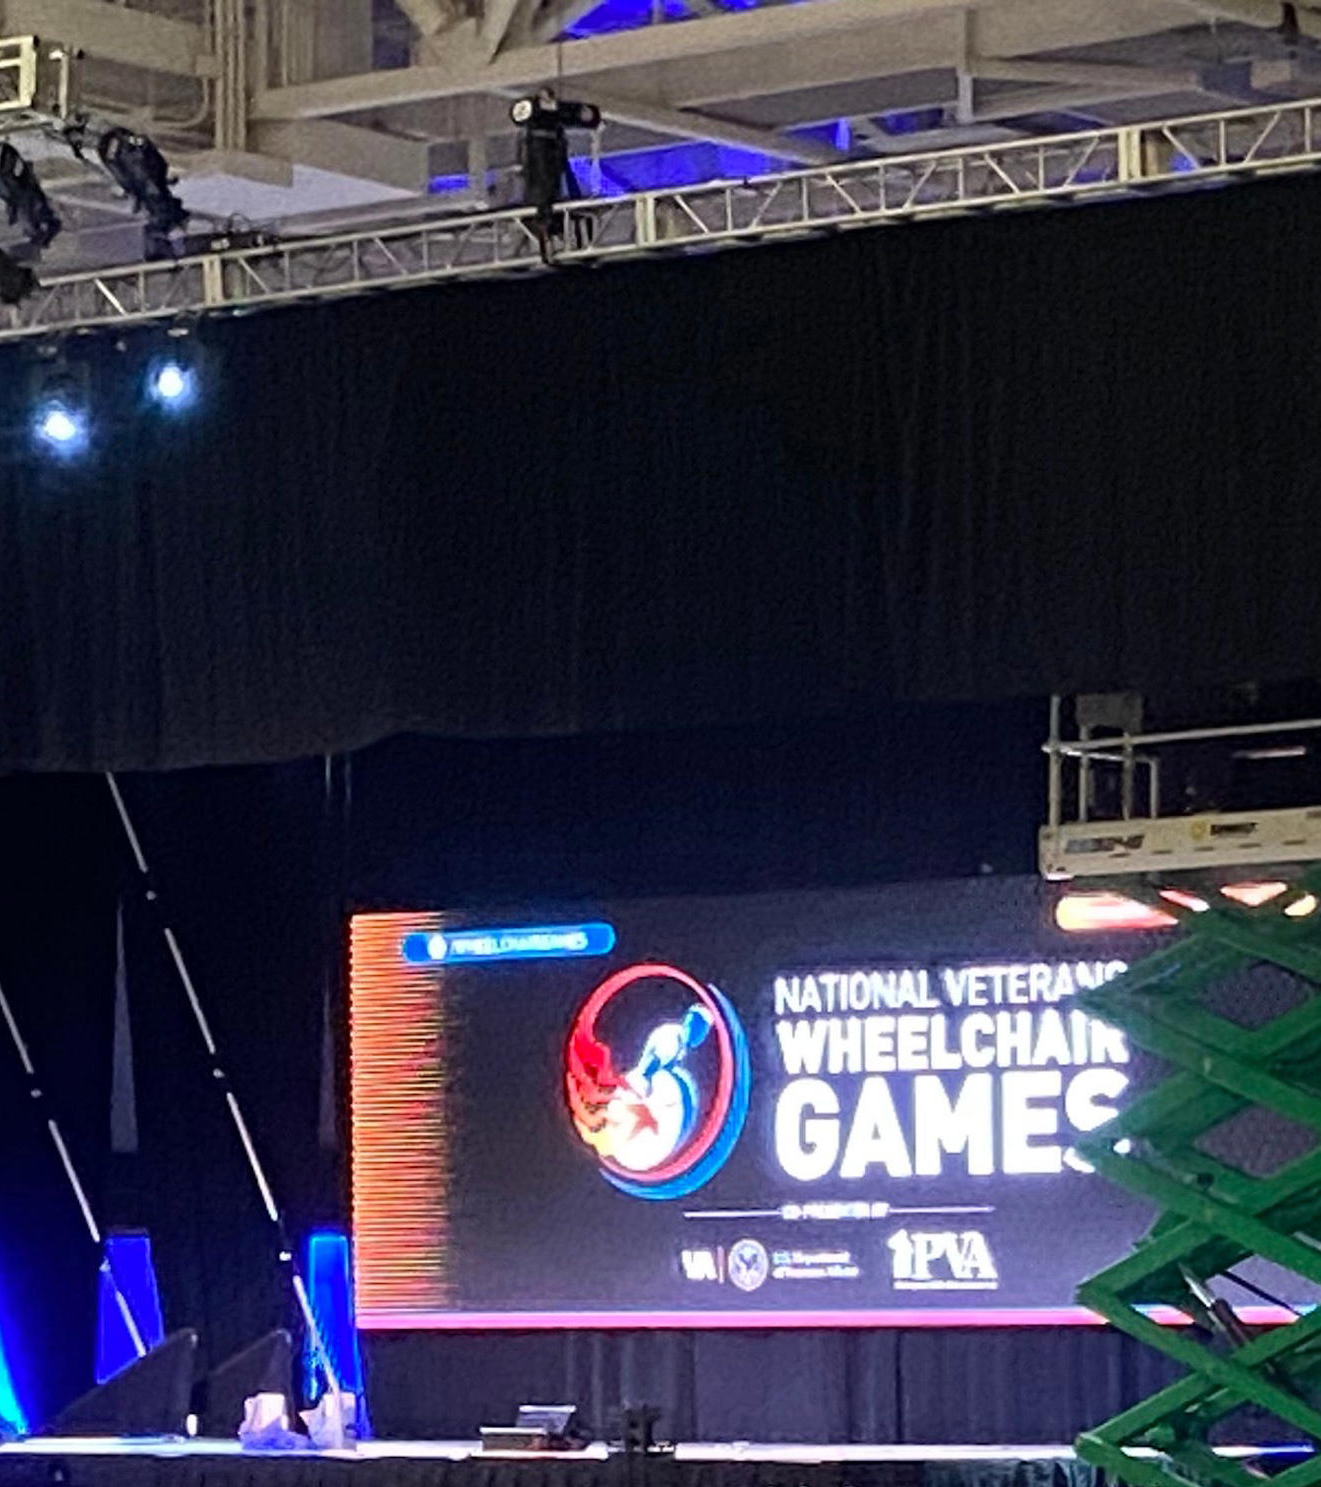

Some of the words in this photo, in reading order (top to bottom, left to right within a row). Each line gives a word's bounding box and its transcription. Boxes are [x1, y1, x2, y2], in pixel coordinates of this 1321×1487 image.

[774, 968, 941, 1015] NATIONAL
[776, 1008, 1130, 1075] WHEELCHAIR
[774, 1068, 1130, 1182] GAMES
[910, 1231, 998, 1280] PVA
